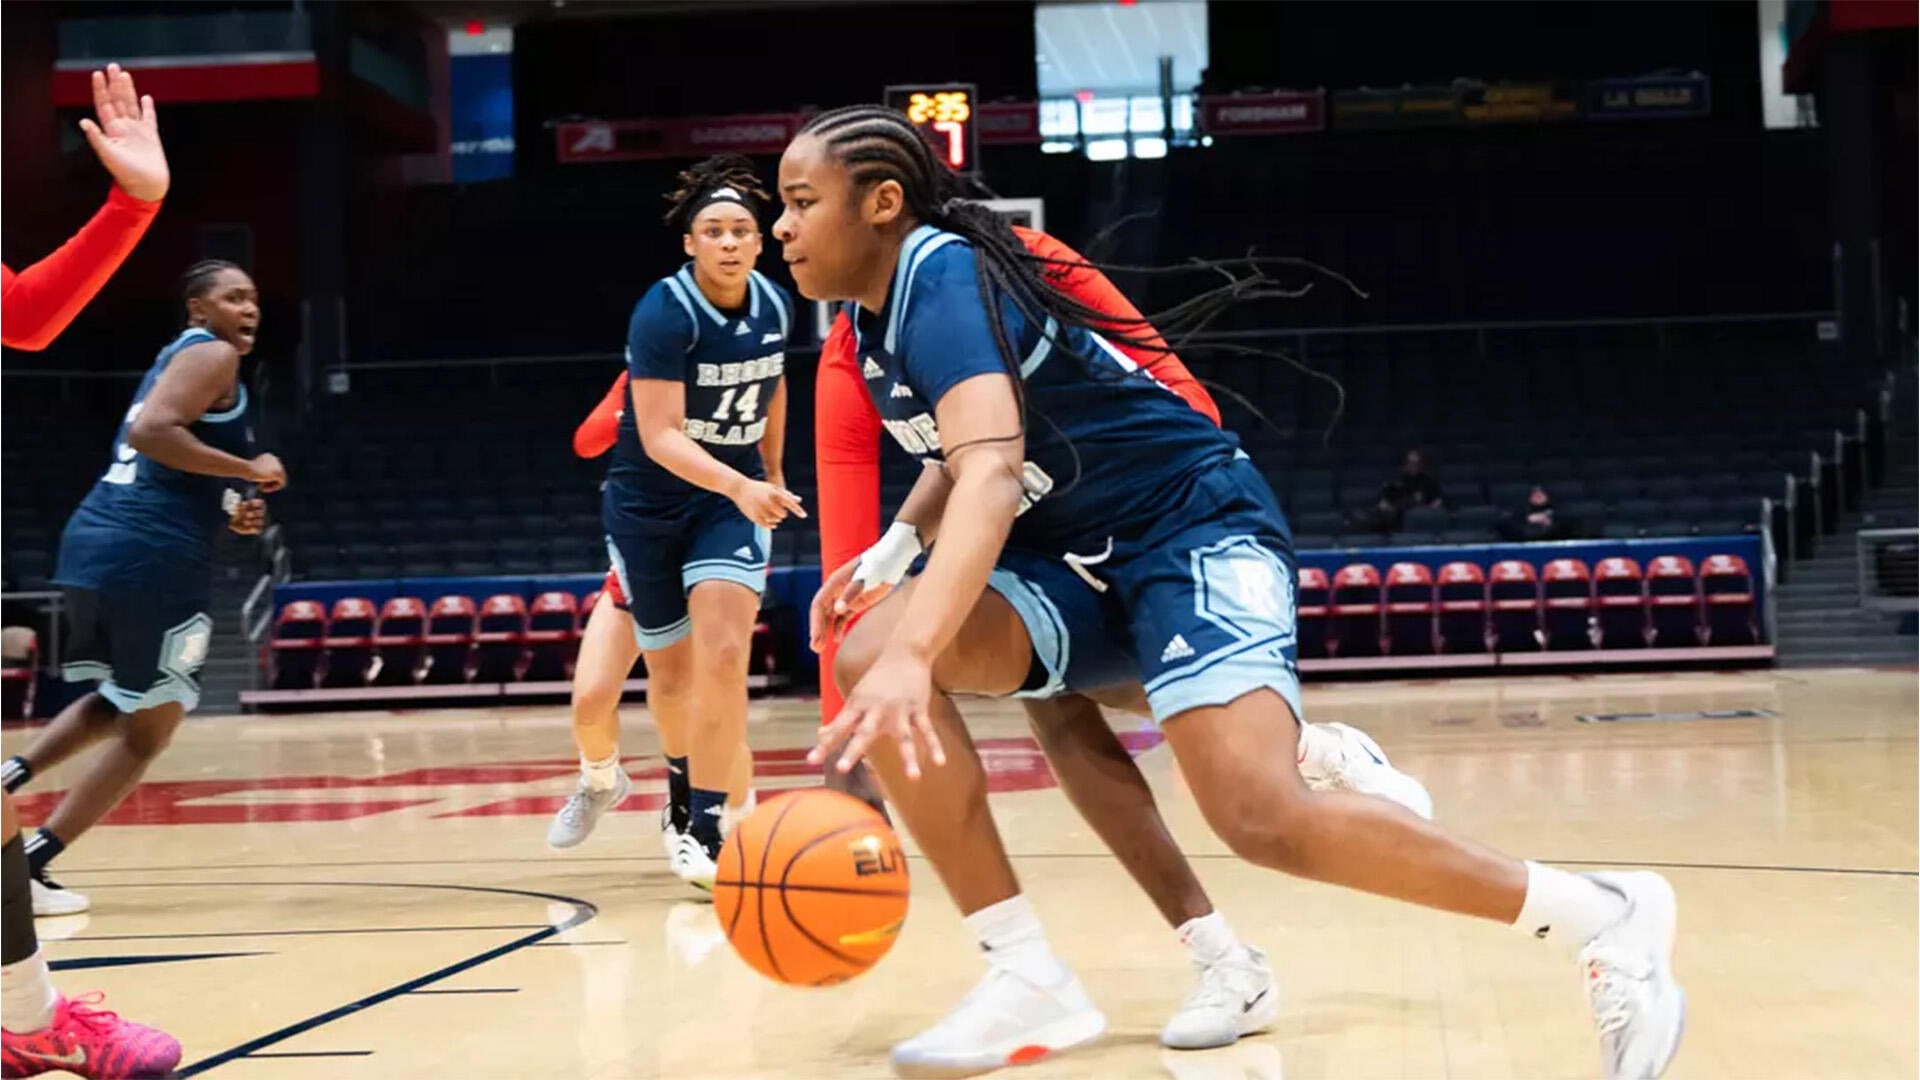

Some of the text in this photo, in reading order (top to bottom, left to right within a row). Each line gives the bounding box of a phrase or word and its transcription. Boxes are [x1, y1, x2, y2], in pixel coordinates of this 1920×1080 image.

[907, 92, 970, 123] 2:35
[1216, 104, 1308, 123] FORDHAM
[711, 383, 762, 422] 14
